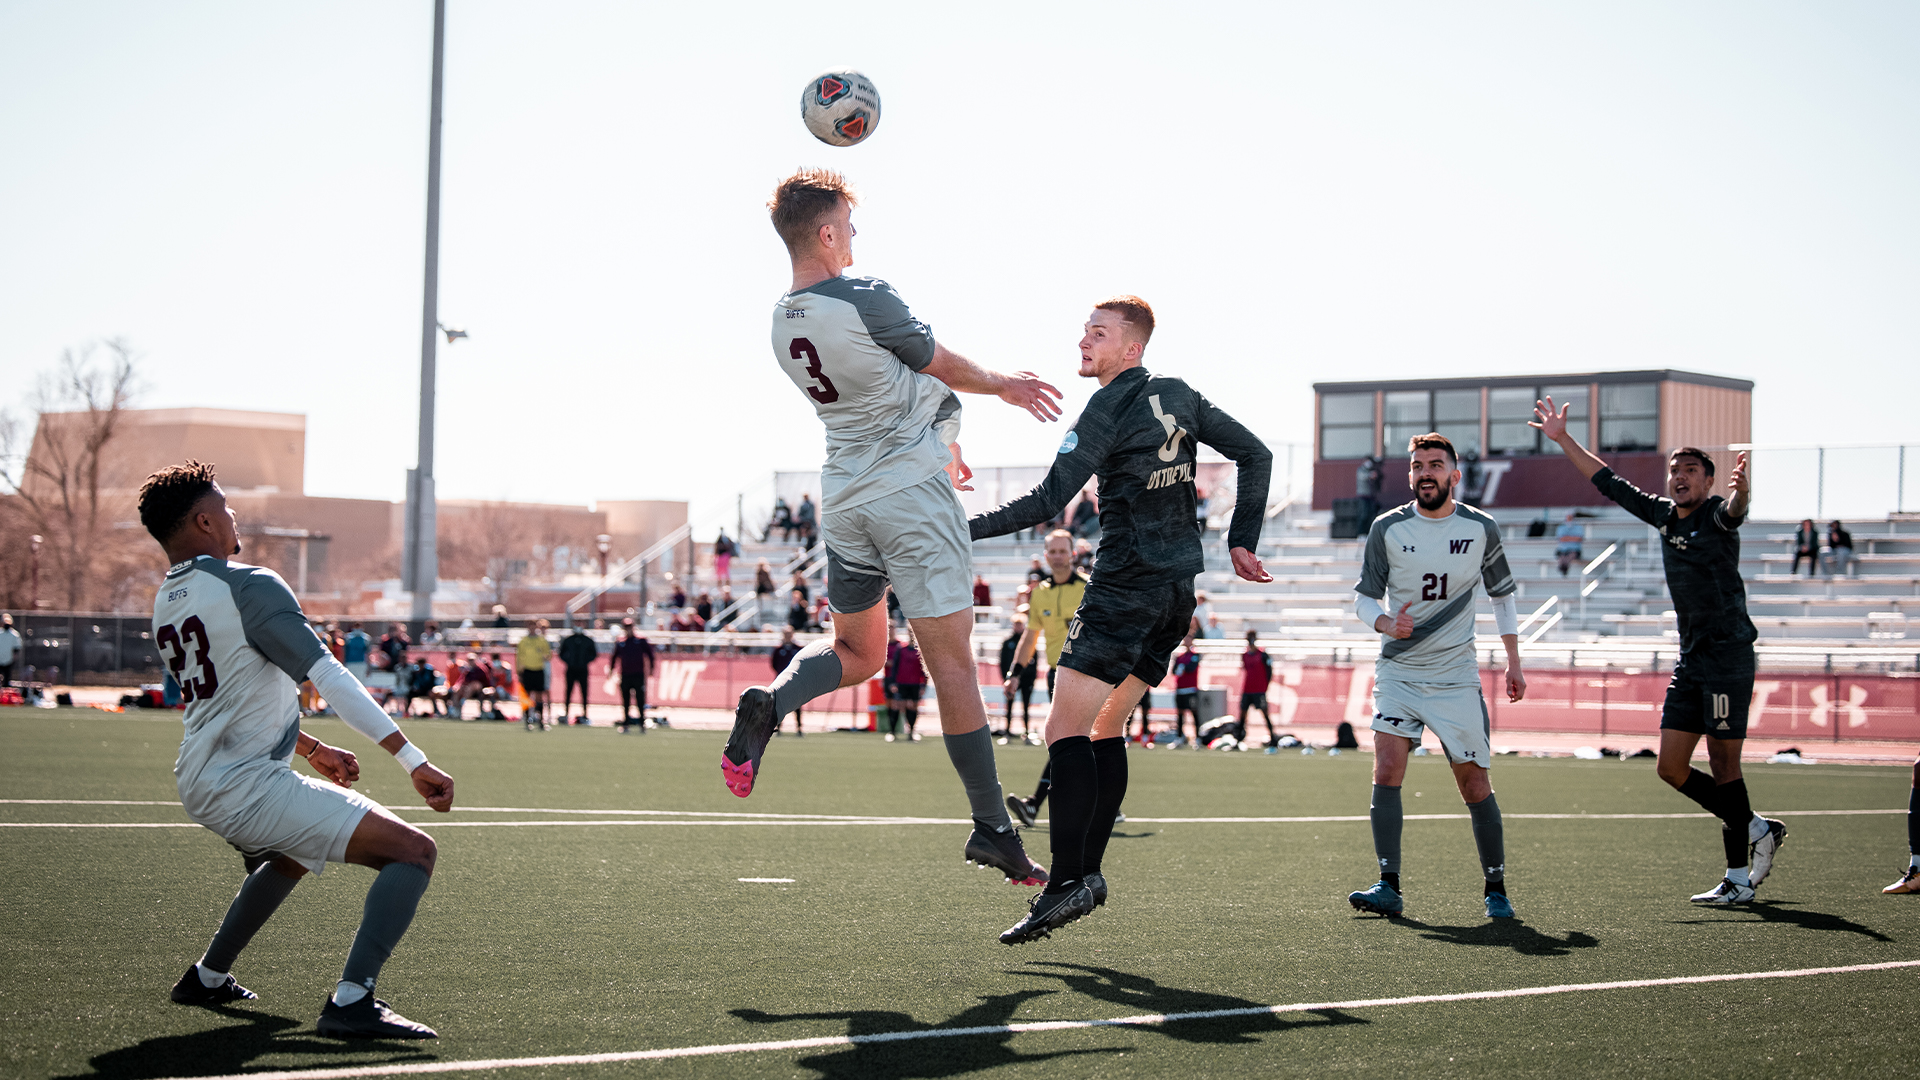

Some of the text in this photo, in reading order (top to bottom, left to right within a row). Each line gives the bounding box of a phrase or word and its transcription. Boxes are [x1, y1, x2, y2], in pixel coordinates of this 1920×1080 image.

[786, 309, 805, 318] BUFFS
[789, 337, 839, 405] 3
[1450, 539, 1474, 554] WT
[168, 587, 188, 602] BUFFS
[1422, 573, 1448, 601] 21
[157, 615, 218, 703] 23
[658, 661, 708, 701] WT
[1712, 693, 1729, 719] 10
